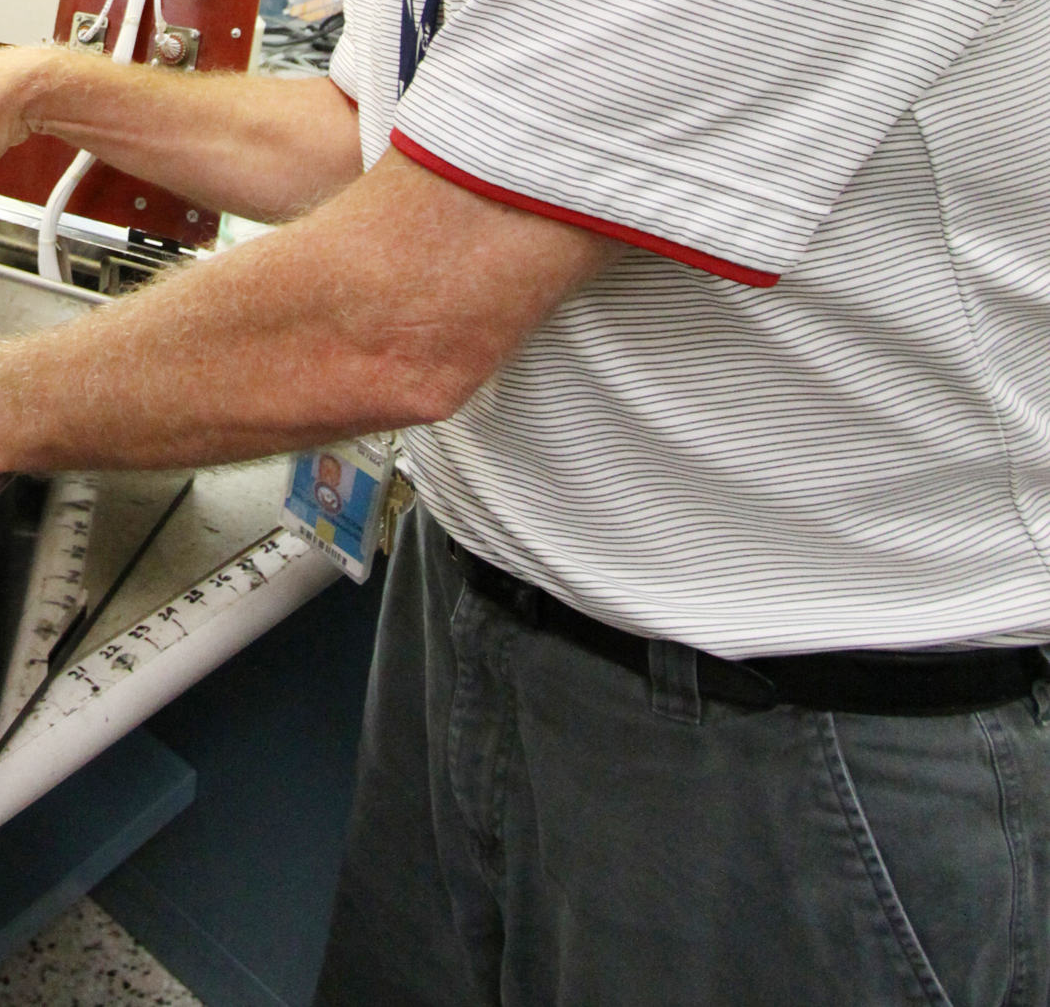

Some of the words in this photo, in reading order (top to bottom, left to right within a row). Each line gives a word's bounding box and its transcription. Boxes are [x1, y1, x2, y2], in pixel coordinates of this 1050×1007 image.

[67, 665, 88, 681] 21
[99, 645, 123, 660] 22
[128, 625, 151, 639] 23
[208, 574, 232, 588] 26
